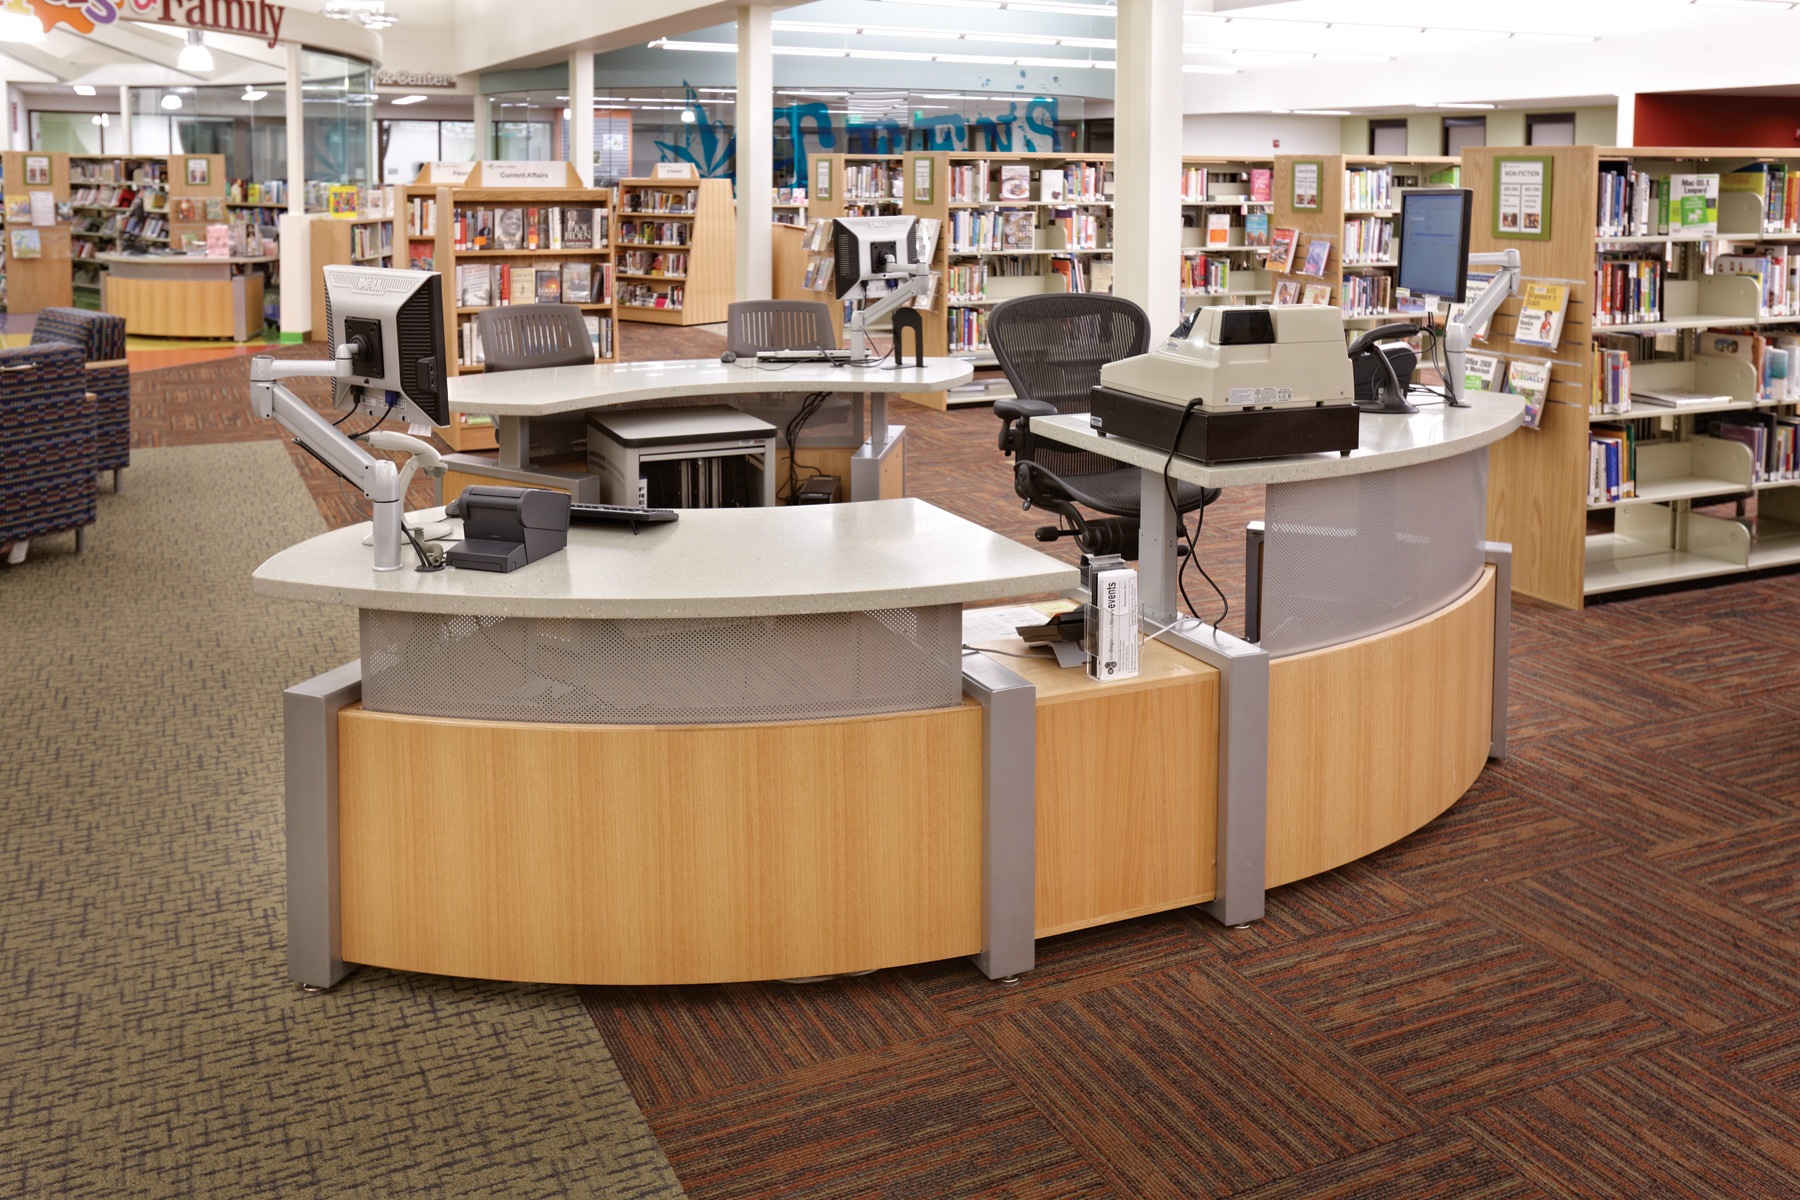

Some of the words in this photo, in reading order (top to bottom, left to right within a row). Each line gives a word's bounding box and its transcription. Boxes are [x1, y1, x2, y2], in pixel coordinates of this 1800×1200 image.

[157, 0, 286, 49] Family
[396, 70, 452, 86] Center
[1682, 179, 1695, 187] Mac
[1684, 187, 1708, 195] Leopard
[574, 223, 591, 233] JOE
[869, 220, 889, 228] DELL
[565, 231, 592, 240] BIDEN
[1511, 372, 1545, 384] VISUALLY
[1107, 581, 1117, 609] events
